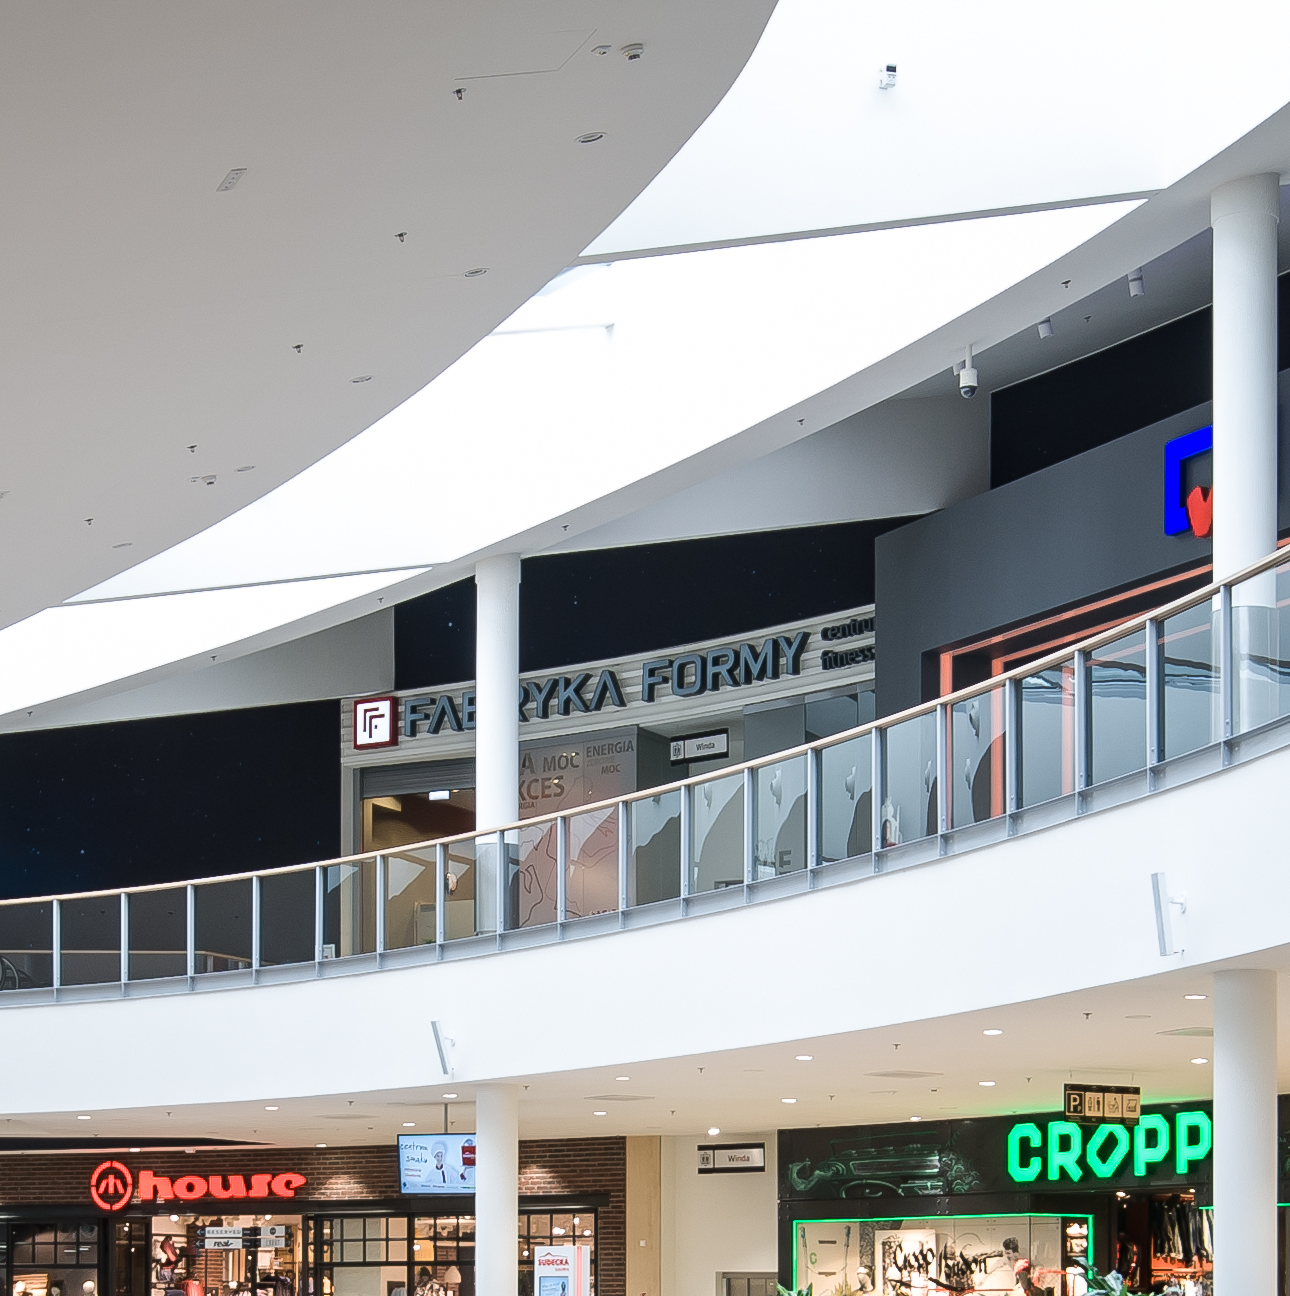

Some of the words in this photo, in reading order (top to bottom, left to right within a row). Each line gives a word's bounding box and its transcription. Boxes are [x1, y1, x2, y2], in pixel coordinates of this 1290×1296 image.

[821, 616, 875, 641] centru
[641, 631, 811, 703] FORMY
[820, 647, 875, 670] fitness
[586, 740, 634, 758] ENERGIA
[542, 751, 579, 773] MOC
[601, 763, 621, 775] MOC
[728, 1154, 751, 1162] Winda
[1008, 1111, 1212, 1182] CROPP
[138, 1170, 307, 1200] house
